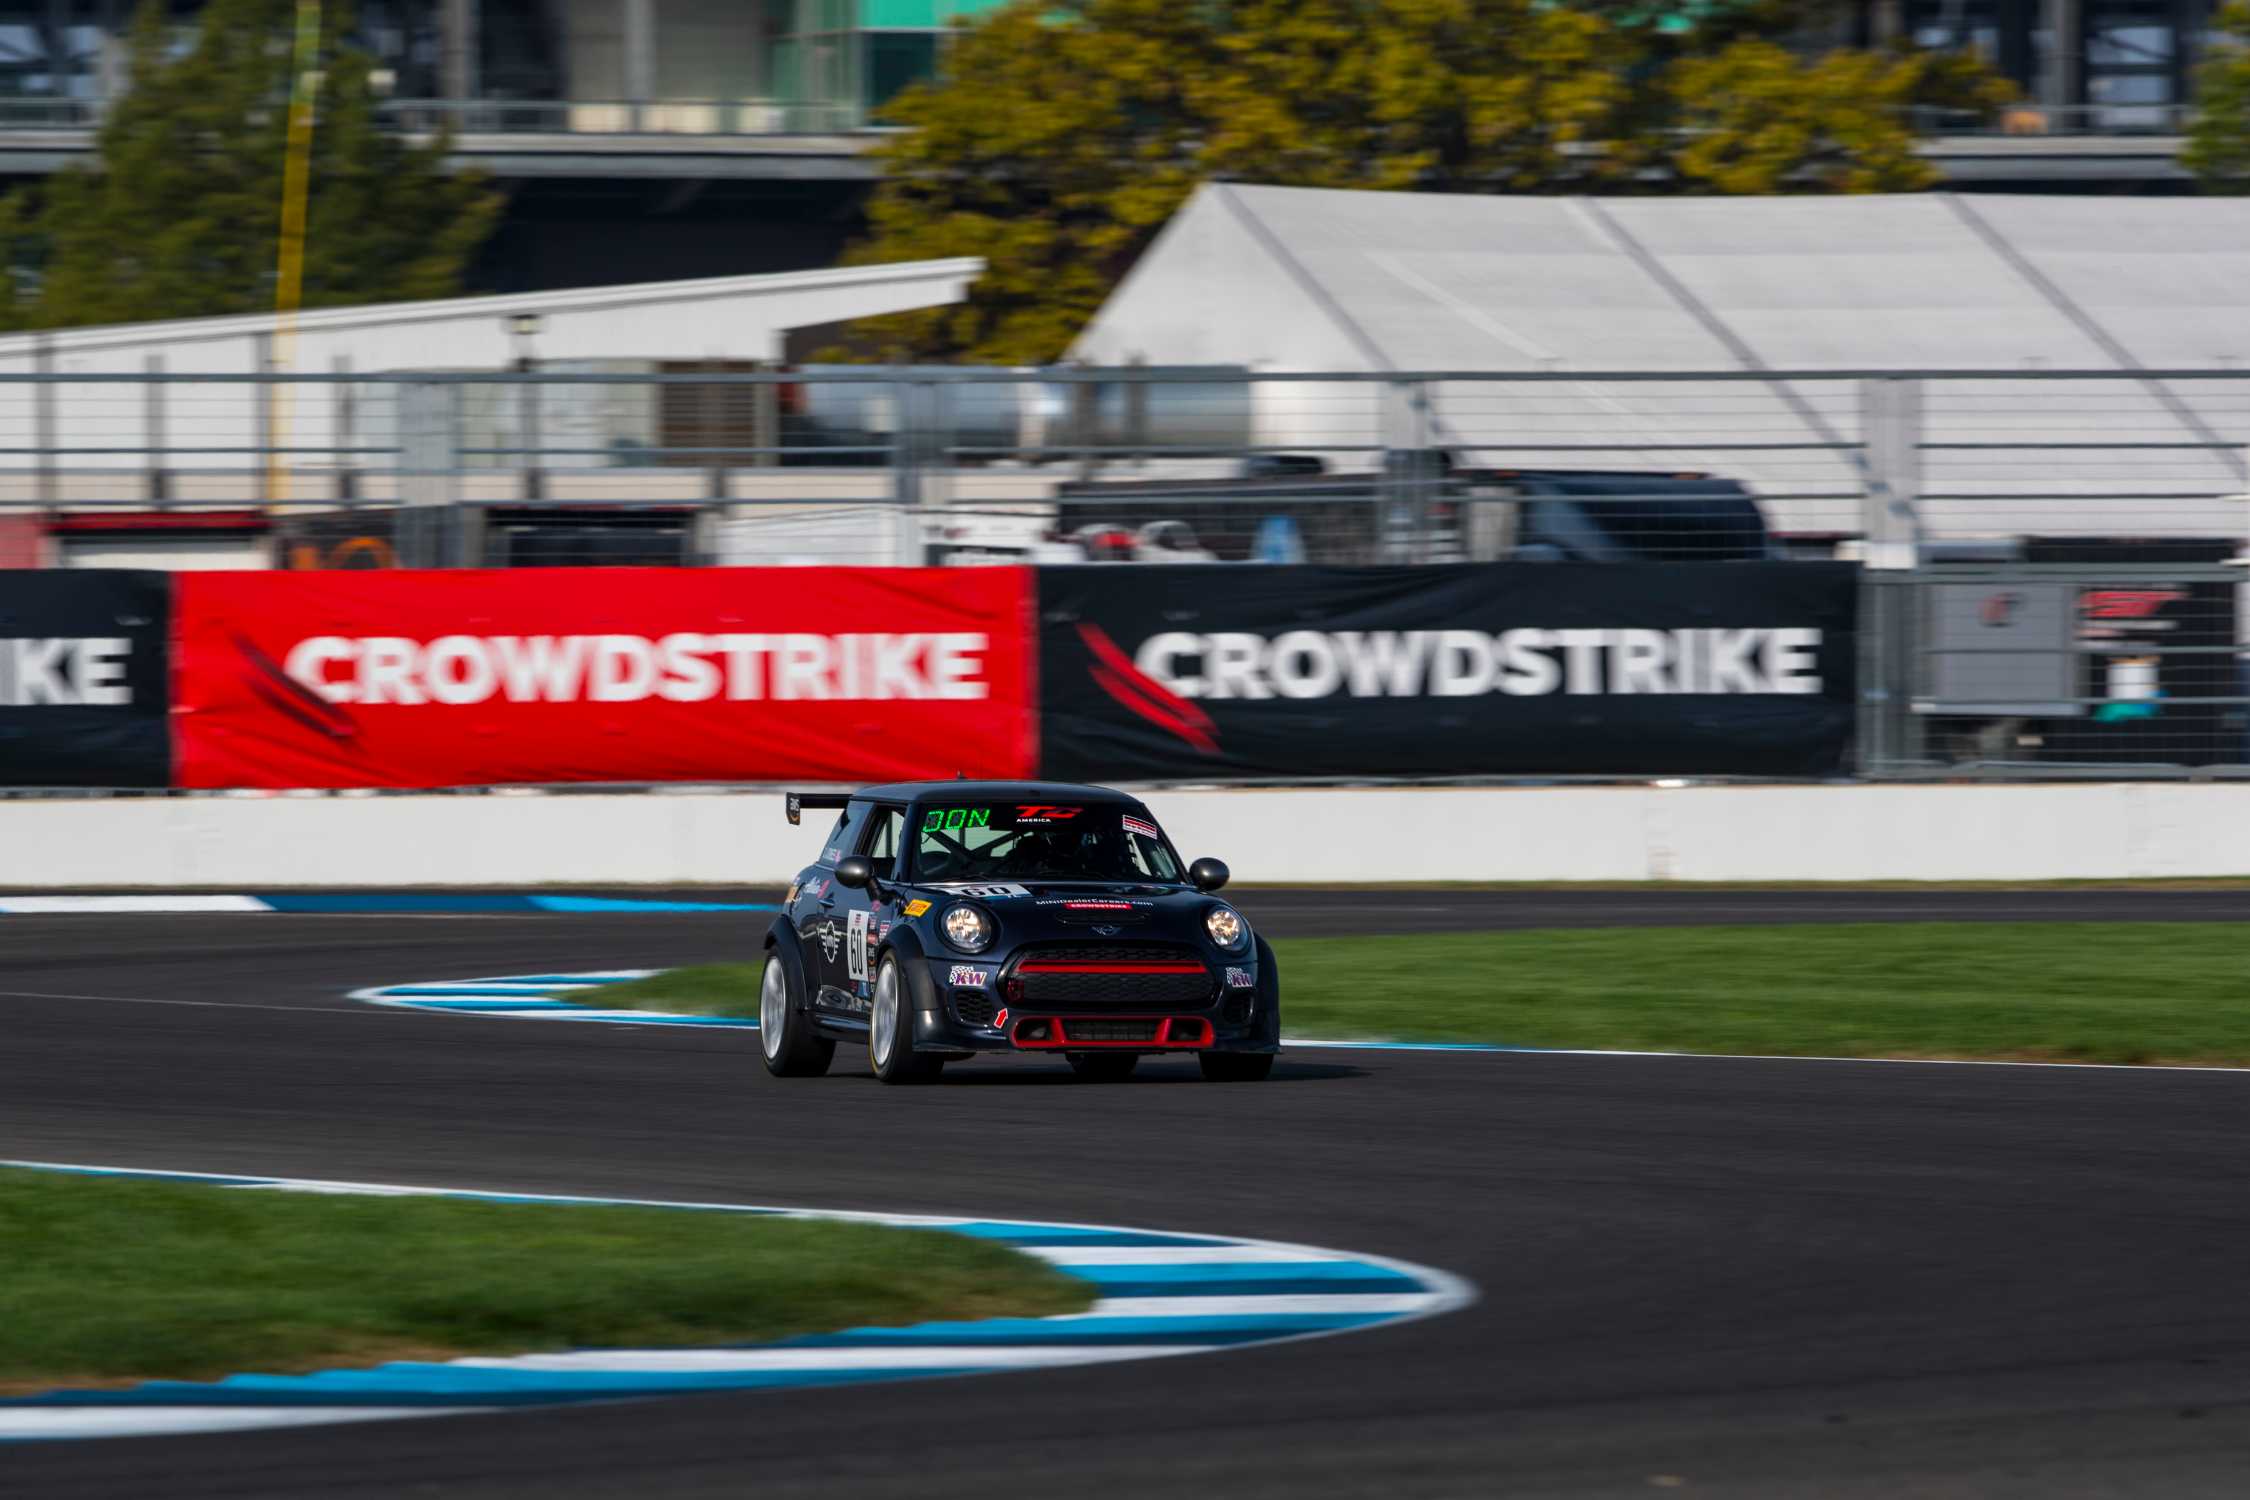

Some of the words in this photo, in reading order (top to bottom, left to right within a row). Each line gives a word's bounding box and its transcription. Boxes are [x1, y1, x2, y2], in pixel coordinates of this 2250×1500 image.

[283, 633, 989, 704] CROWDSTRIKE
[1136, 628, 1824, 698] CROWDSTRIKE
[851, 927, 863, 975] 60
